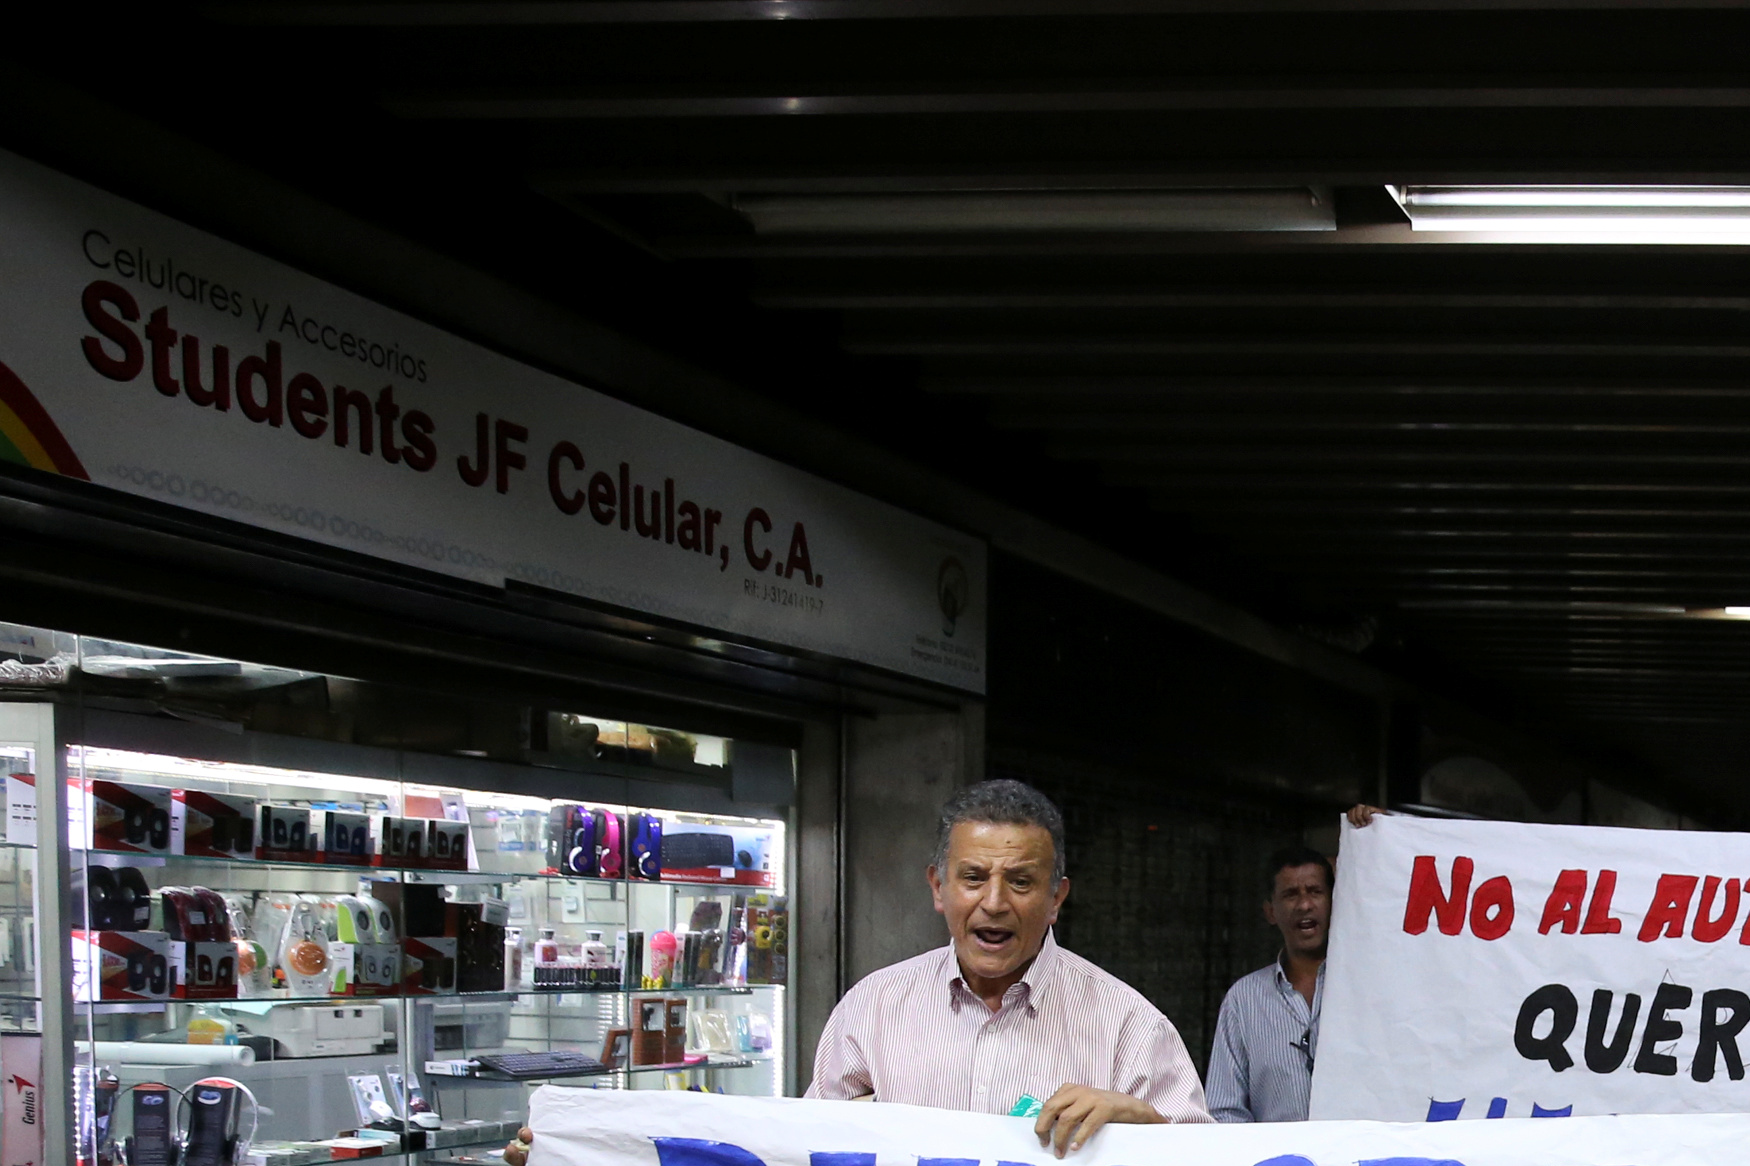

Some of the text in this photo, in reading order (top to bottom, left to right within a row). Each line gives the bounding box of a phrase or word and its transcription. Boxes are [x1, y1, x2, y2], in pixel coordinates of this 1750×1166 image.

[82, 229, 428, 383] Celulares y Accesorios
[80, 280, 823, 588] Students JF Celular, C.A.
[1538, 868, 1623, 936] AL
[22, 1091, 35, 1125] Genius
